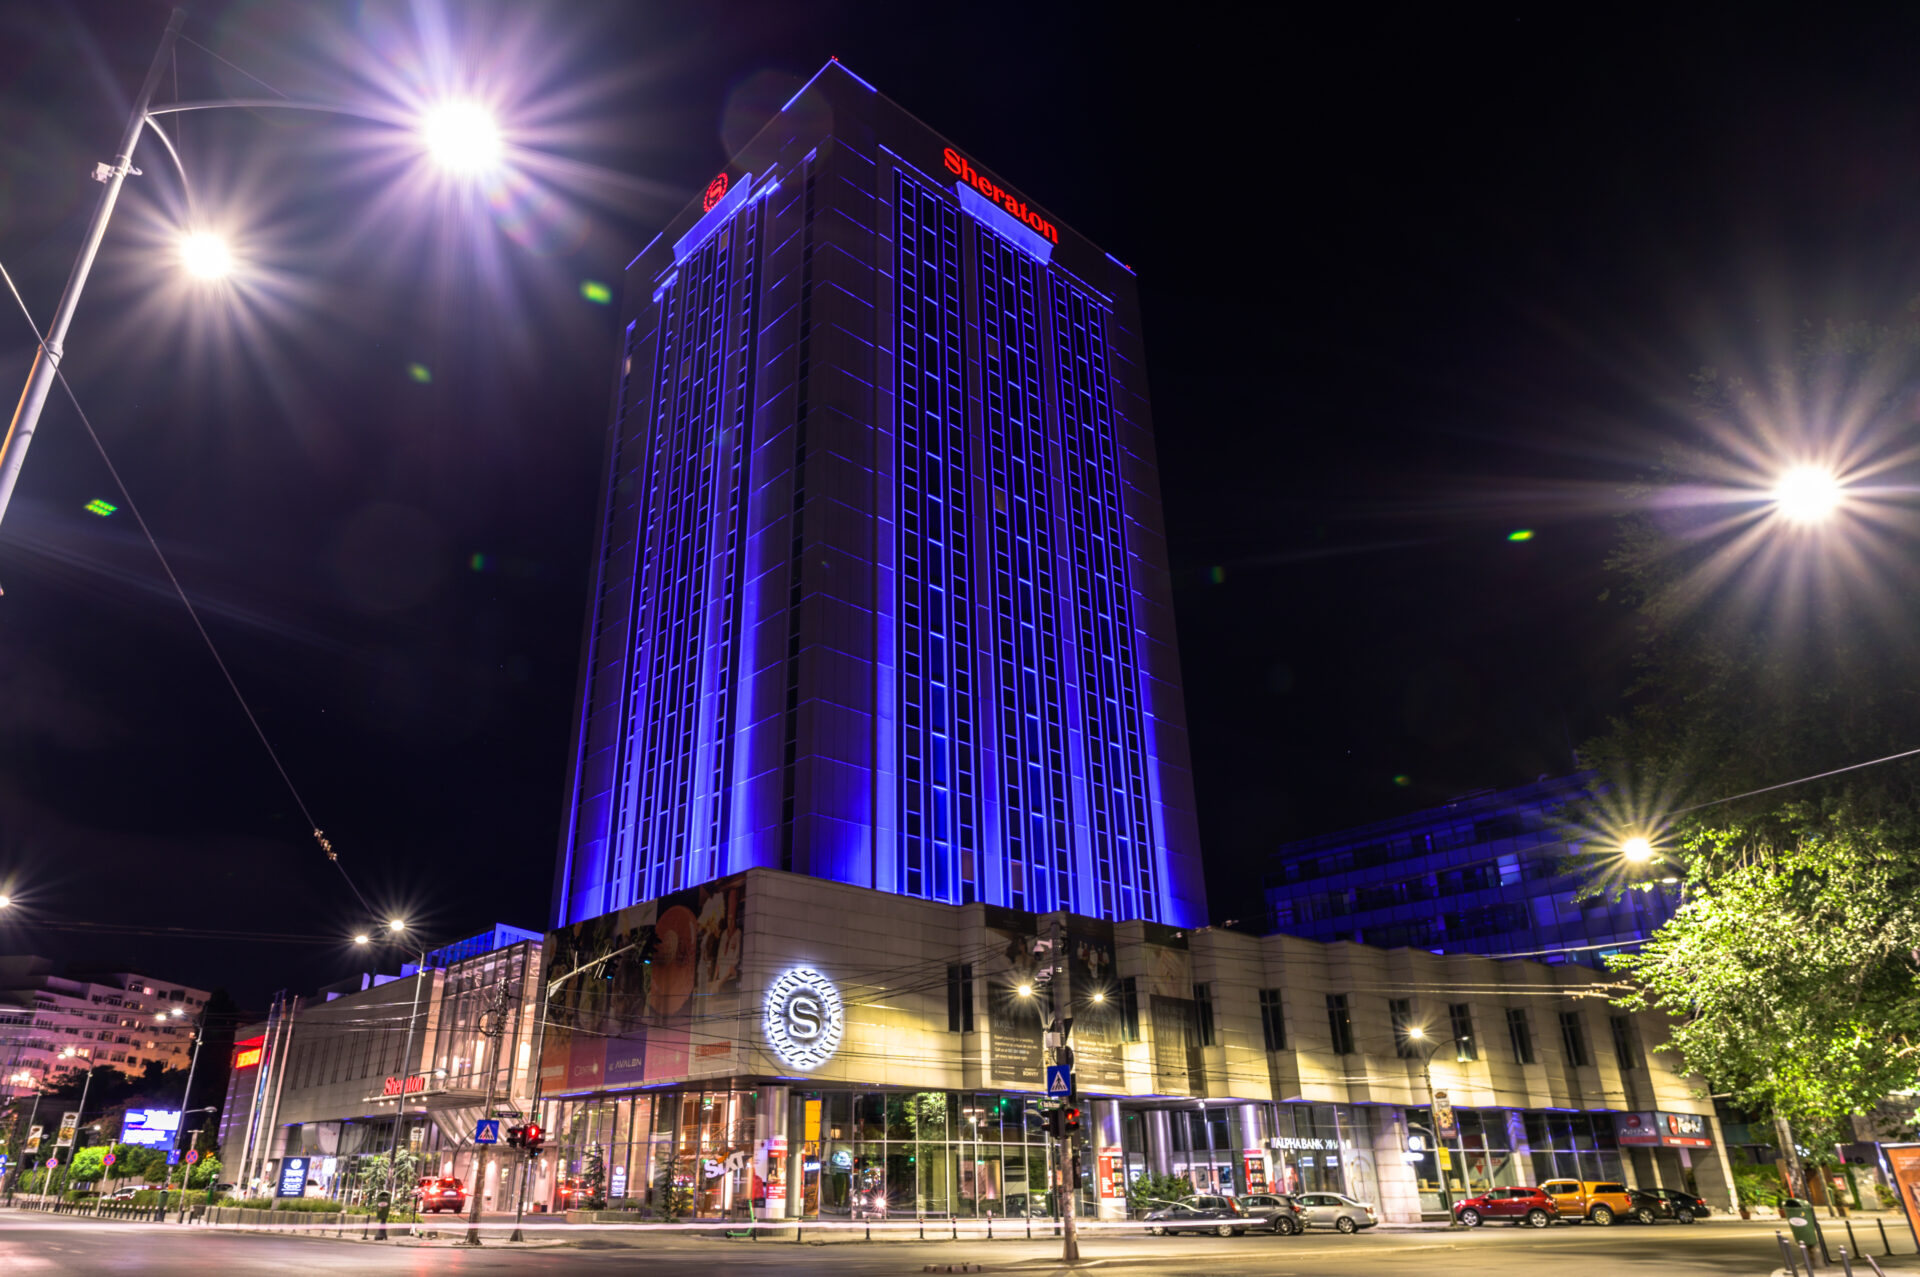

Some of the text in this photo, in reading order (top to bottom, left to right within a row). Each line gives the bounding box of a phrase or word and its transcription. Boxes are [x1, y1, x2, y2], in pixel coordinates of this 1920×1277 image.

[943, 147, 1059, 244] Sheraton
[788, 996, 820, 1039] S
[1301, 1137, 1324, 1150] BANK
